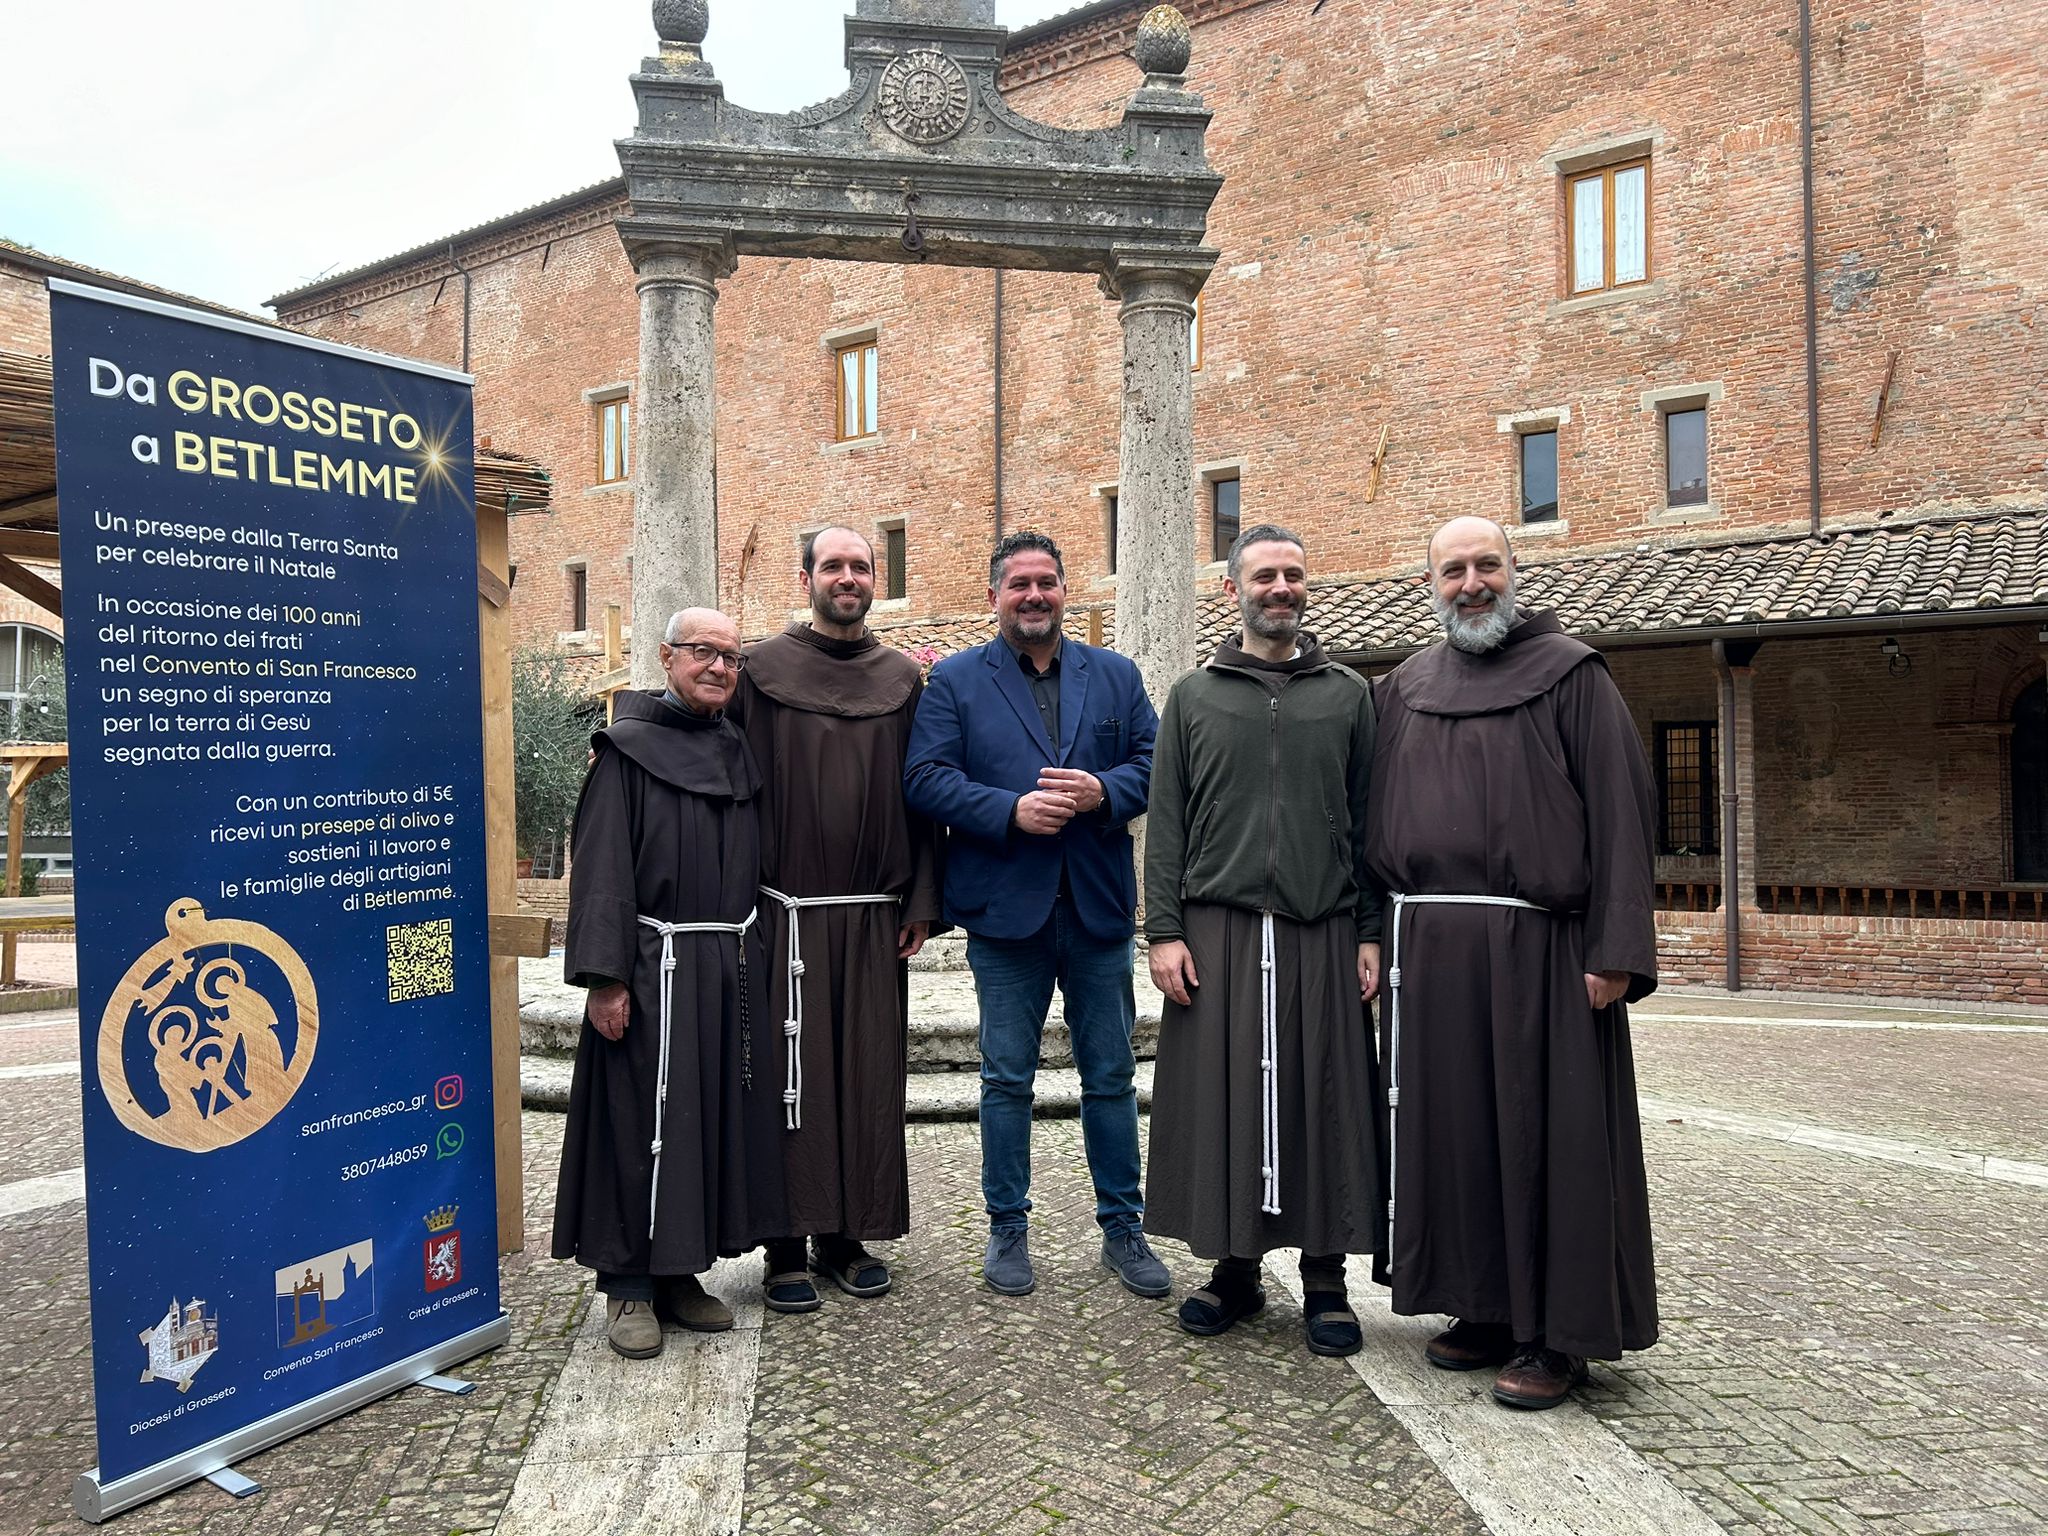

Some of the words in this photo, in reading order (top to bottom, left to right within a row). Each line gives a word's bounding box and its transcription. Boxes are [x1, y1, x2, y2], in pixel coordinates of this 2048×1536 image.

[89, 357, 156, 406] Da
[168, 370, 421, 451] GROSSETO
[131, 435, 160, 464] a
[174, 430, 417, 504] BETLEMME
[95, 511, 127, 532] Un
[136, 519, 226, 544] presepe
[232, 527, 282, 548] dalla
[288, 533, 338, 553] Terra
[344, 539, 398, 560] Santa
[97, 545, 136, 564] per
[143, 548, 249, 572] celebrare
[255, 555, 263, 573] il
[270, 558, 336, 579] Natale
[98, 594, 118, 612] In
[127, 599, 241, 619] occasione
[247, 604, 276, 621] dei
[283, 606, 316, 624] 100
[322, 610, 360, 626] anni
[99, 624, 134, 644] del
[143, 627, 217, 646] ritorno
[224, 630, 254, 647] dei
[260, 631, 302, 649] frati
[101, 654, 135, 672] nel
[143, 655, 250, 675] Convento
[256, 659, 273, 676] di
[280, 660, 317, 677] San
[324, 661, 416, 679] Francesco
[102, 688, 130, 702] un
[139, 689, 207, 706] segno
[214, 685, 232, 703] di
[240, 690, 331, 707] speranza
[103, 718, 142, 736] per
[150, 714, 169, 731] la
[175, 715, 229, 731] terra
[237, 713, 254, 731] di
[261, 714, 310, 730] Gesù
[104, 743, 200, 766] segnata
[207, 741, 259, 759] dalla
[266, 744, 336, 762] guerra.
[236, 796, 277, 812] Con
[284, 796, 307, 810] un
[313, 789, 408, 808] contributo
[413, 786, 428, 802] di
[434, 786, 453, 801] 5€
[211, 822, 264, 842] ricevi
[271, 824, 295, 838] un
[302, 817, 374, 839] presepe
[380, 813, 395, 830] di
[401, 812, 440, 828] olivo
[444, 813, 454, 825] e
[288, 842, 359, 864] sostieni
[370, 840, 377, 856] il
[383, 839, 436, 855] lavoro
[441, 838, 450, 850] e
[221, 881, 238, 898] le
[243, 872, 325, 895] famiglie
[330, 867, 373, 887] degli
[378, 861, 450, 881] artigiani
[343, 894, 359, 911] di
[302, 1094, 427, 1136] sanfrancesco_gr
[341, 1144, 427, 1181] 3807448059
[409, 1304, 430, 1320] Città
[432, 1300, 440, 1310] di
[442, 1288, 478, 1306] Grosseto
[264, 1356, 312, 1380] Convento
[315, 1347, 333, 1360] San
[335, 1326, 384, 1352] Francesco
[130, 1410, 171, 1434] Diocesi
[174, 1405, 184, 1416] di
[187, 1387, 236, 1411] Grosseto
